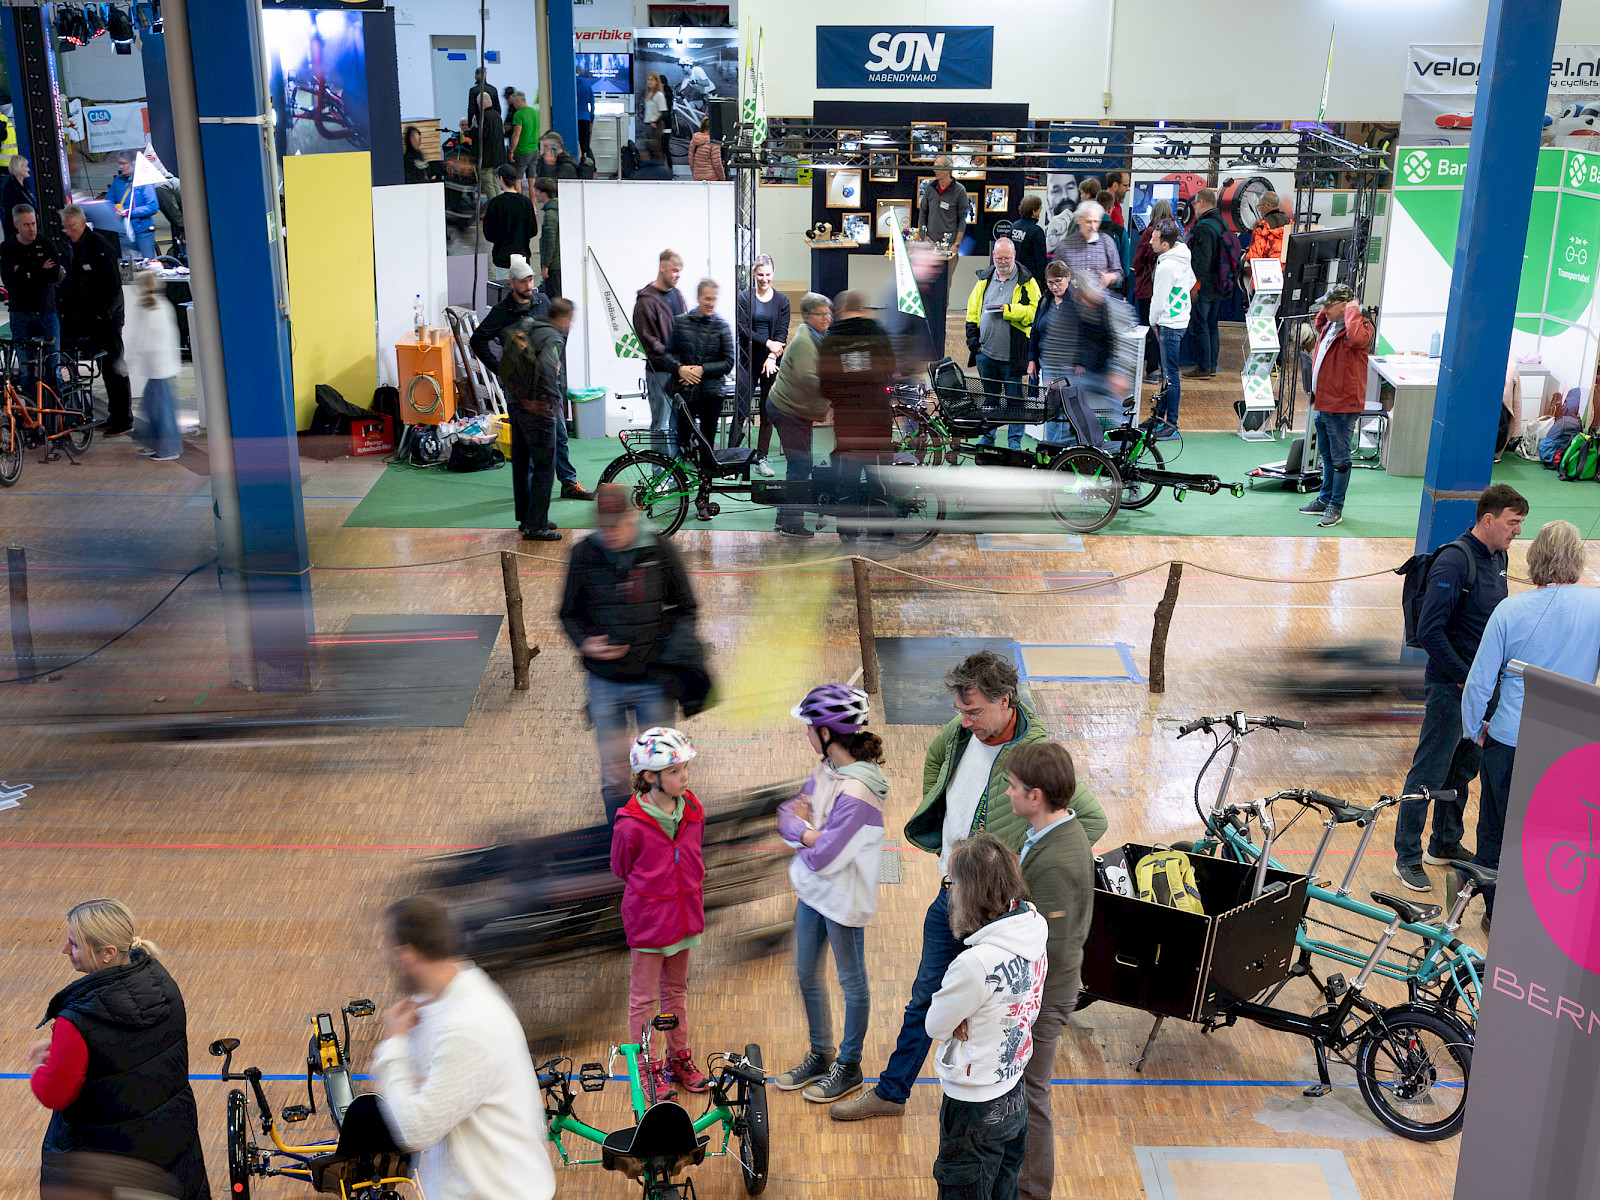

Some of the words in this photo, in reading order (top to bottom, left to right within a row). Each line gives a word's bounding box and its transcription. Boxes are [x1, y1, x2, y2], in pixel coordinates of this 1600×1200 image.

[575, 29, 632, 40] varibike
[864, 32, 946, 72] SON
[868, 73, 937, 83] NABENDYNAMO
[1560, 79, 1599, 88] cyclists
[89, 113, 110, 122] CASA
[1011, 229, 1027, 241] SON
[1557, 267, 1591, 283] Transportabel
[604, 290, 620, 332] BamBuk.de
